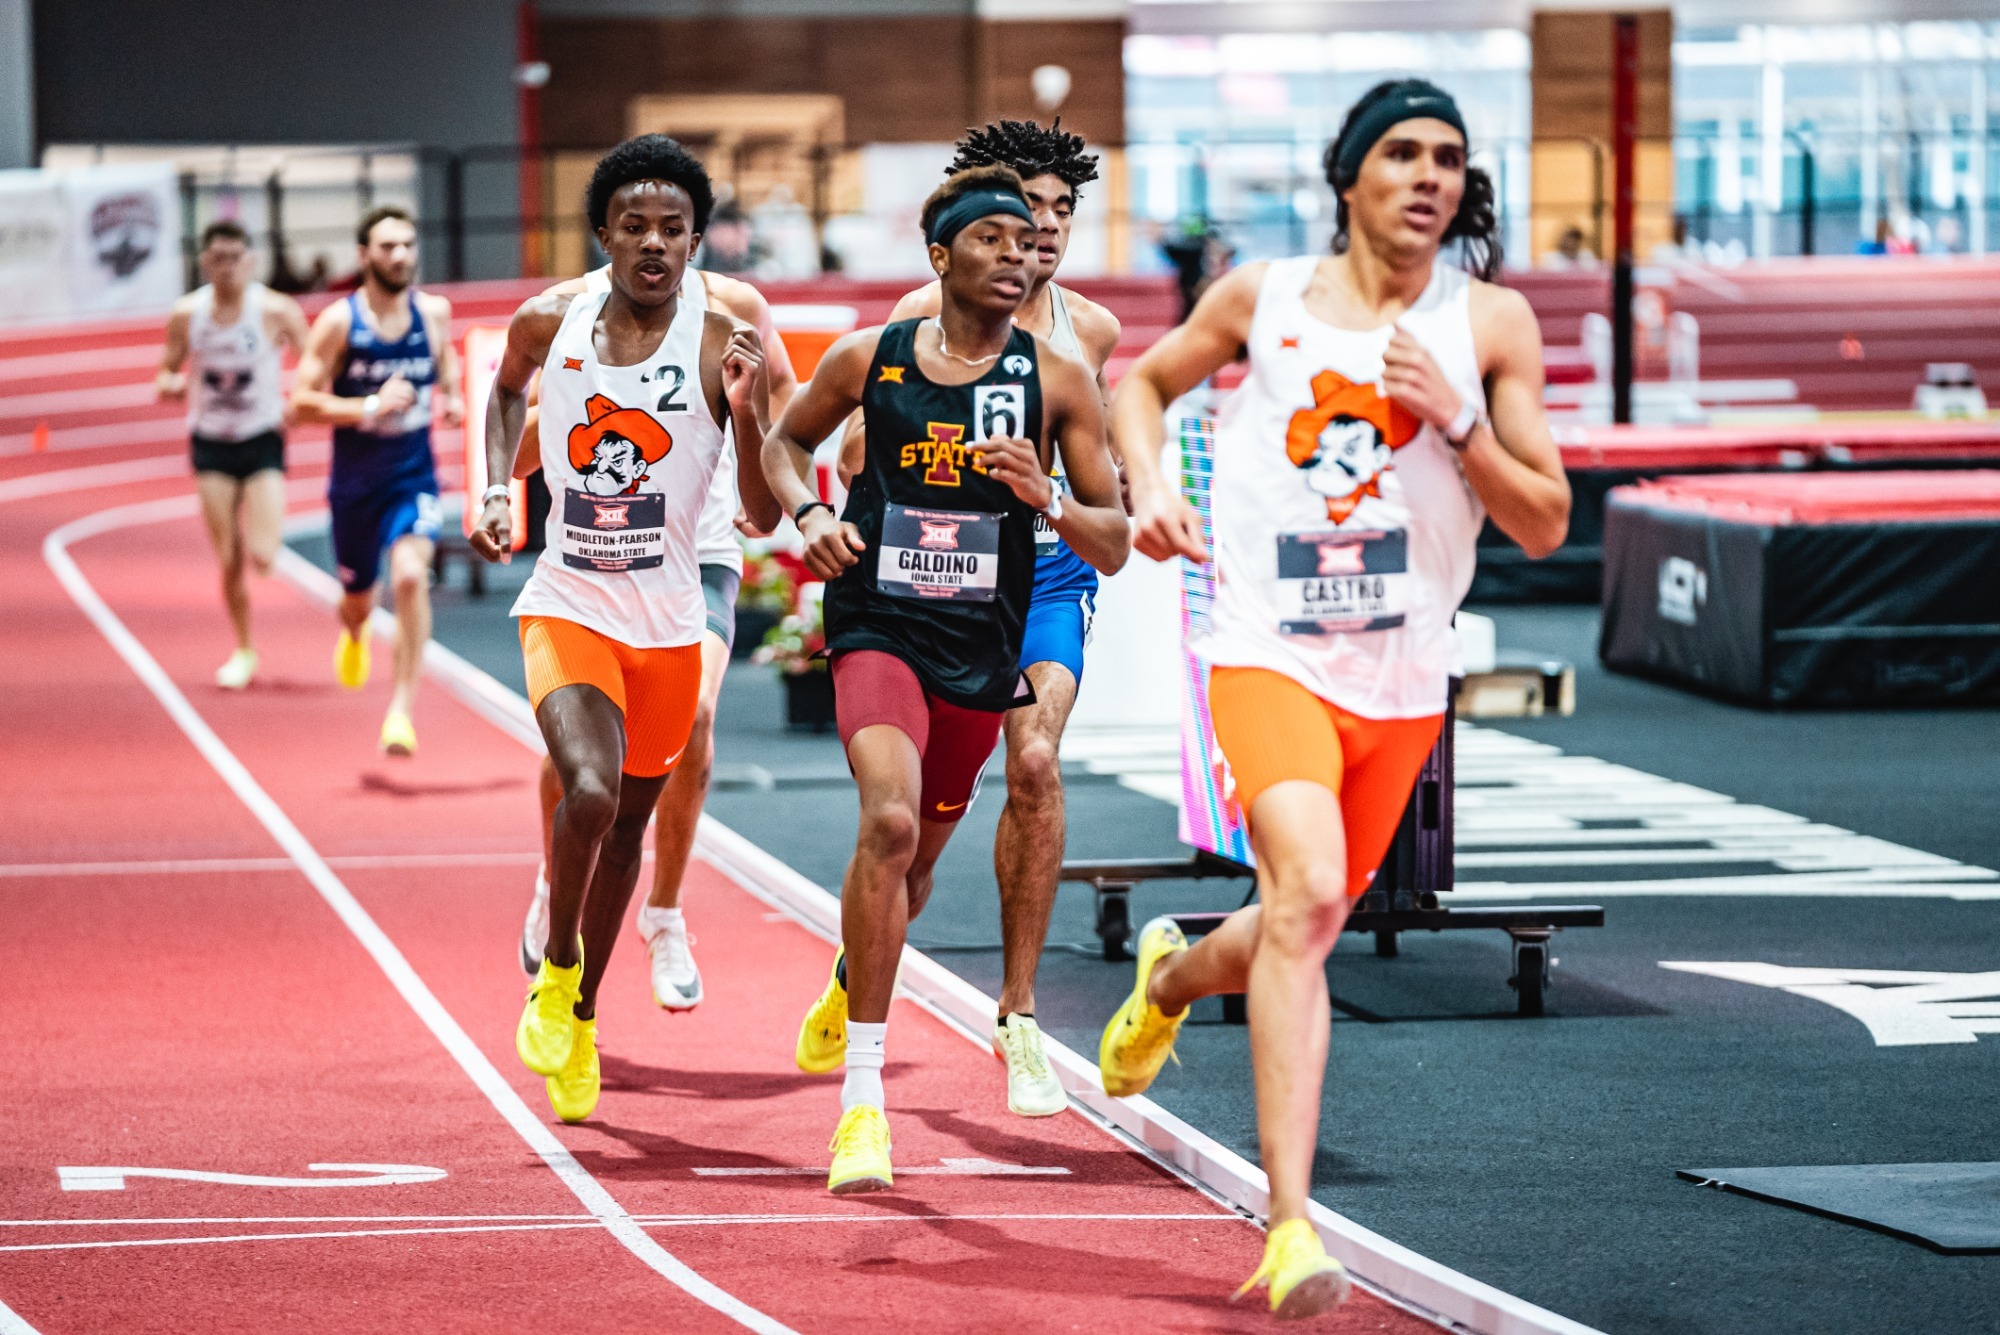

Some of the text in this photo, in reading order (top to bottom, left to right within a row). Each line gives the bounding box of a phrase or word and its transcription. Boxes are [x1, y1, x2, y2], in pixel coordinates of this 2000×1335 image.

[655, 365, 687, 412] 2
[983, 391, 1017, 440] 6
[901, 442, 988, 476] STATE
[566, 529, 661, 546] MIDDLETON-PEARSON
[578, 547, 646, 559] OKLAHOMA STATE
[899, 550, 978, 575] GALDINO
[911, 572, 963, 585] IOWA STATE
[1302, 577, 1385, 602] CASTRO
[57, 1162, 449, 1191] 2
